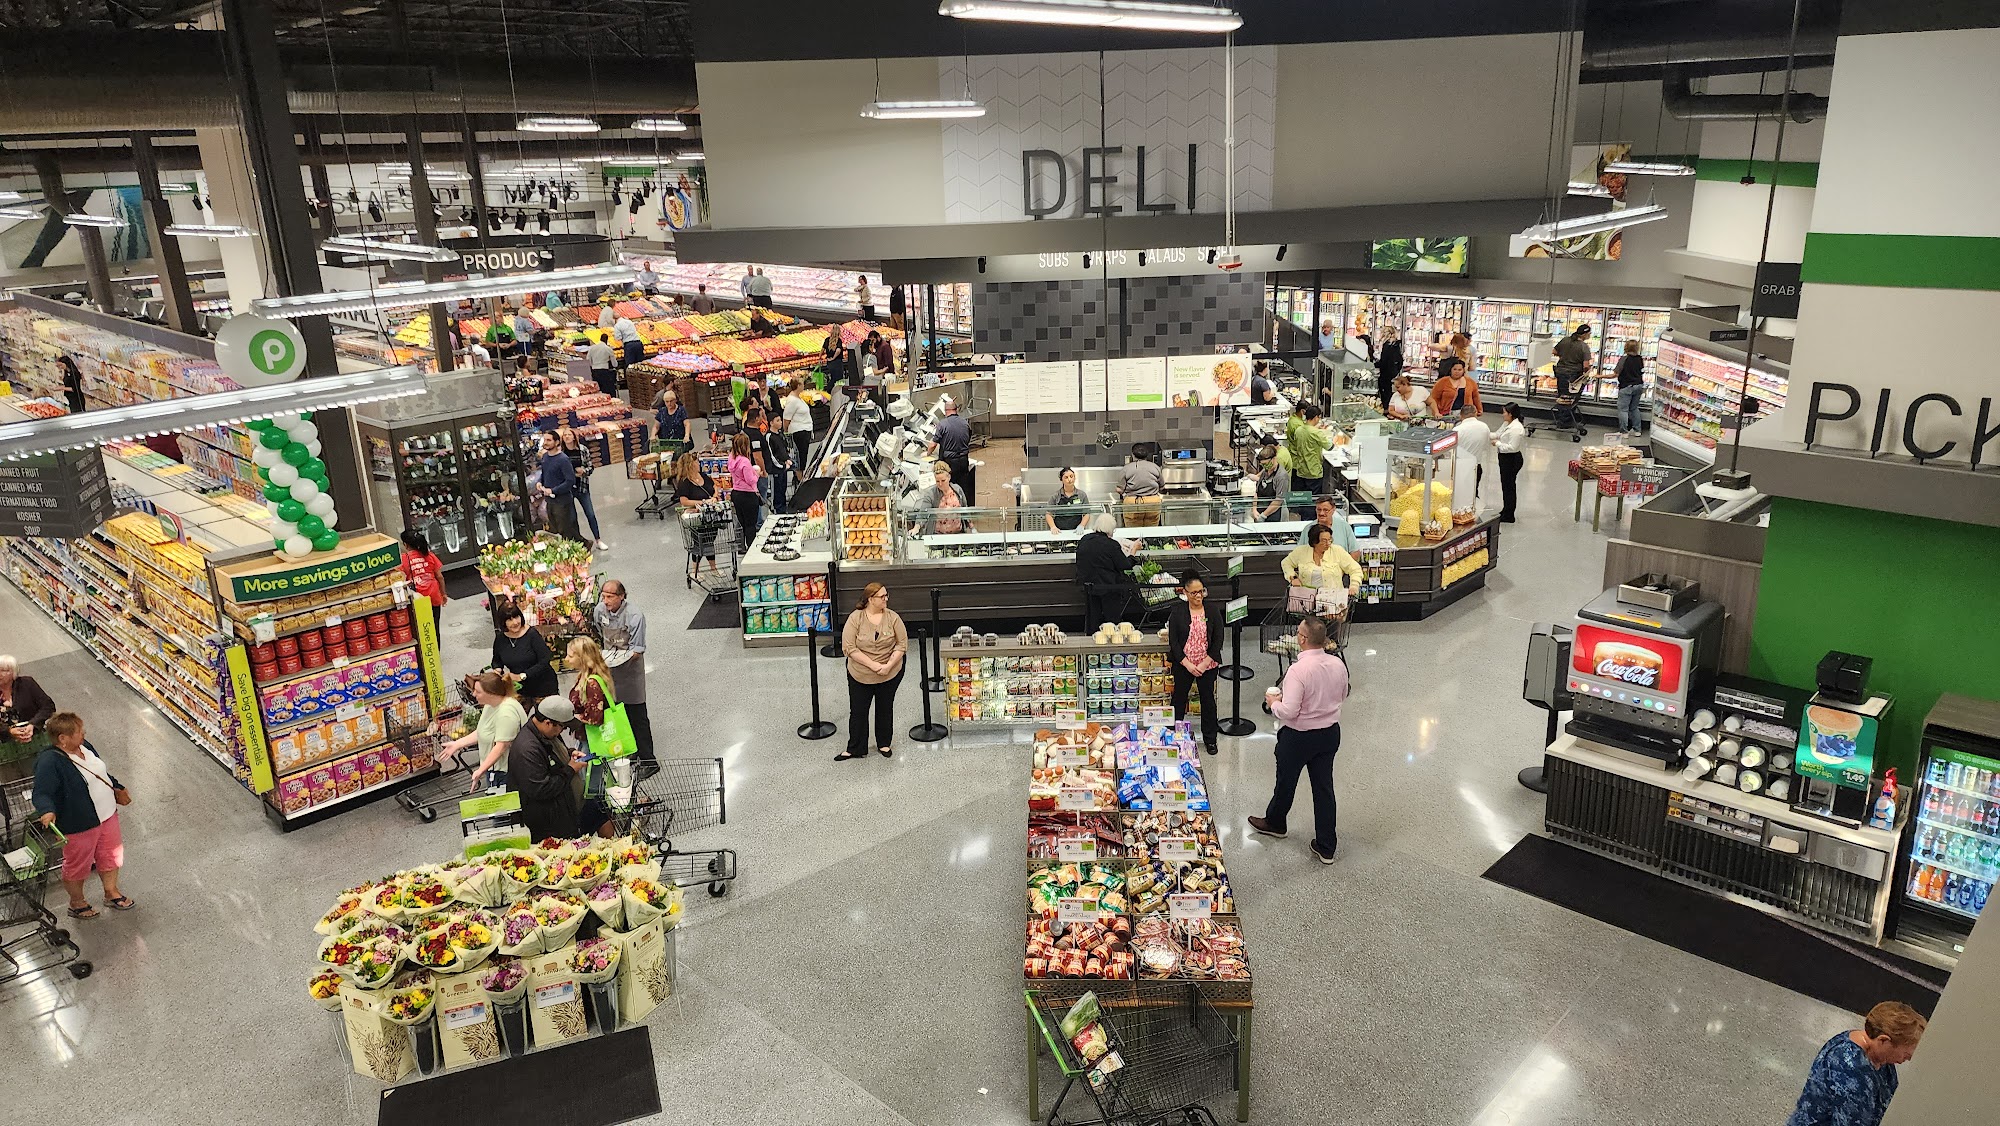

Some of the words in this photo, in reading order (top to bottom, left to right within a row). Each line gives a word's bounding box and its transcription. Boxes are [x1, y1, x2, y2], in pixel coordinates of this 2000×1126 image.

[1022, 143, 1197, 216] DELI
[462, 251, 541, 271] PRODUC
[1038, 251, 1069, 269] SUBS
[1139, 247, 1186, 264] ALADS
[1760, 284, 1795, 297] GRAB
[21, 467, 40, 478] FRUIT
[1632, 467, 1670, 478] SANDWICHES
[1637, 474, 1643, 482] &
[1643, 475, 1663, 484] SOUPS
[0, 482, 26, 493] CANNED
[26, 482, 43, 493] MEAT
[40, 498, 58, 508] FOOD
[16, 511, 42, 522] KOSHER
[23, 525, 41, 536] SOUP
[243, 578, 289, 594] More
[292, 564, 349, 587] savings
[350, 560, 366, 574] to
[367, 552, 395, 569] love.
[422, 621, 431, 642] Save
[424, 642, 436, 657] big
[428, 657, 436, 668] on
[1596, 658, 1659, 686] Coca-Cola
[237, 672, 247, 695] Save
[241, 695, 253, 712] big
[245, 712, 254, 725] on
[248, 724, 265, 767] essentials
[1954, 753, 1972, 762] COLD
[1800, 759, 1825, 771] Worth
[1800, 765, 1821, 775] every
[1821, 770, 1834, 779] sip.
[1842, 770, 1866, 783] $1.49
